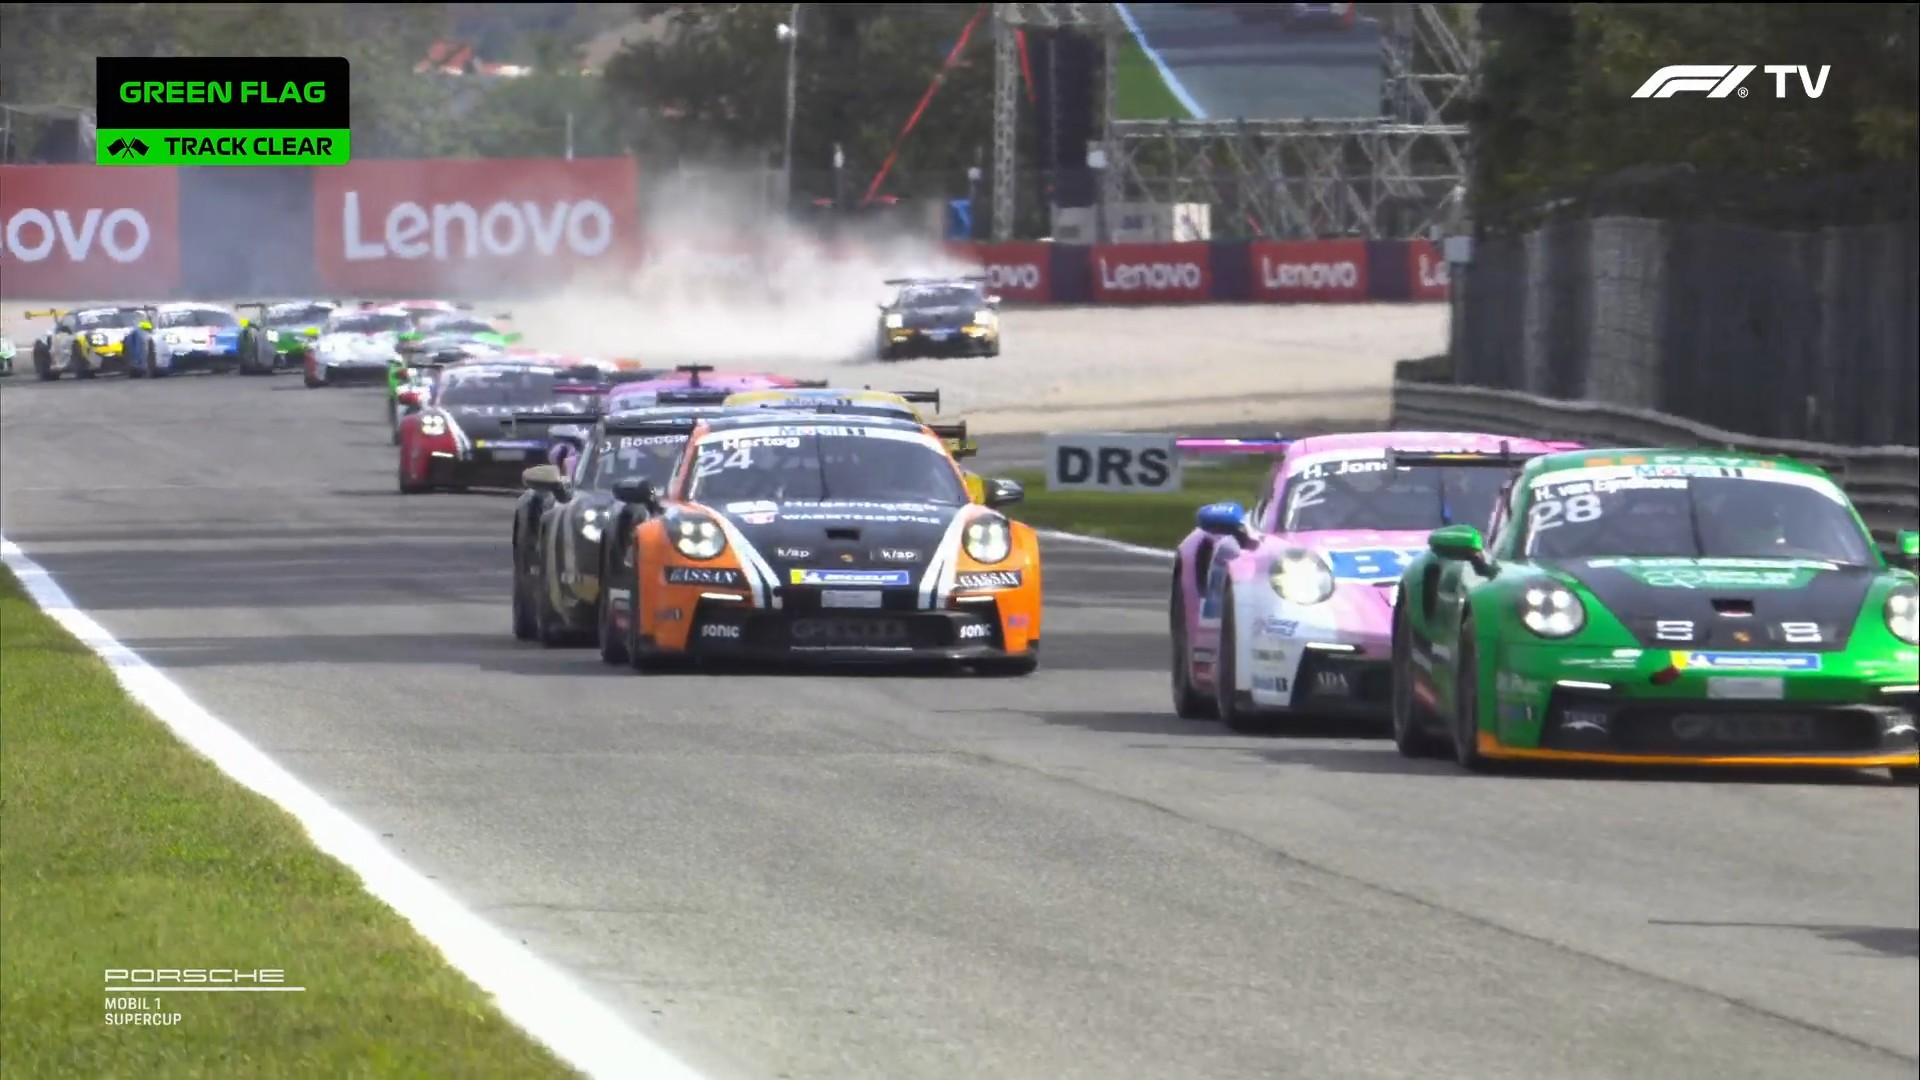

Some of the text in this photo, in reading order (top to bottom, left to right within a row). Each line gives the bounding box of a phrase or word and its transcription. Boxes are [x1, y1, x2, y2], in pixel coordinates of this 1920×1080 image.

[0, 207, 149, 262] ovo
[344, 191, 612, 261] Lenovo
[984, 262, 1039, 290] ovo
[1100, 257, 1200, 290] Lenovo
[1261, 254, 1358, 289] Lenovo
[1418, 253, 1451, 287] Le
[697, 446, 753, 477] 24
[1056, 445, 1170, 487] DRS
[1296, 480, 1326, 509] 2
[1535, 486, 1556, 501] H.
[1530, 494, 1603, 531] 28
